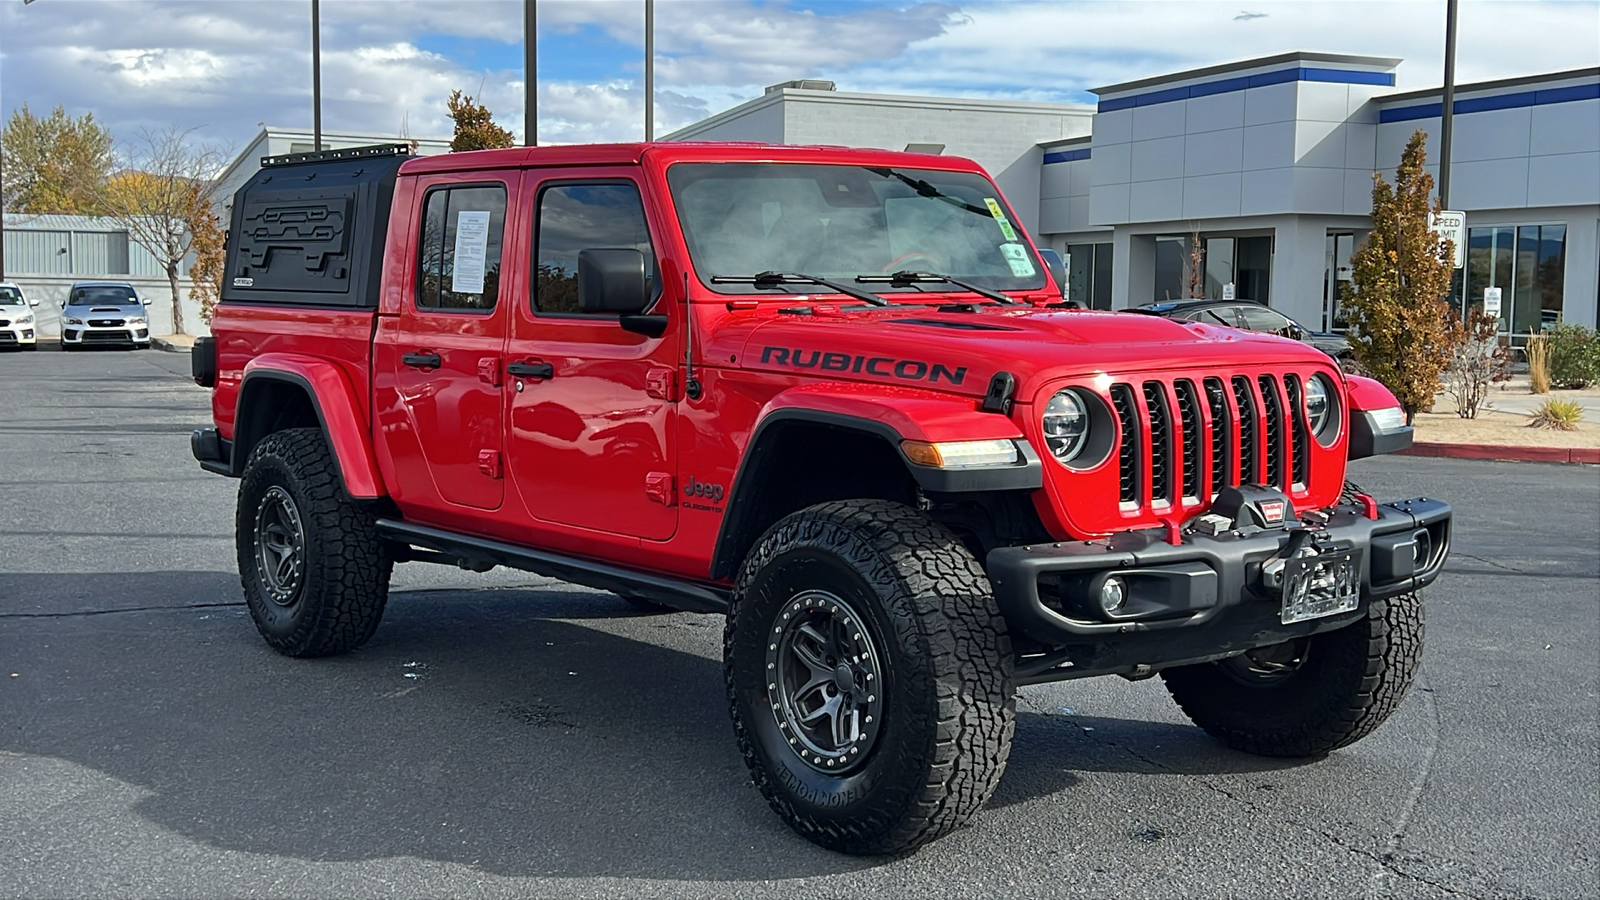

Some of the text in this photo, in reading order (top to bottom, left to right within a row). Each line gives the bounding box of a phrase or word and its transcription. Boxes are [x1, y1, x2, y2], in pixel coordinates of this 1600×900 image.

[1433, 218, 1460, 227] PEED
[1437, 230, 1457, 238] IMIT
[760, 346, 968, 385] RUBICON
[683, 475, 724, 503] Jeep
